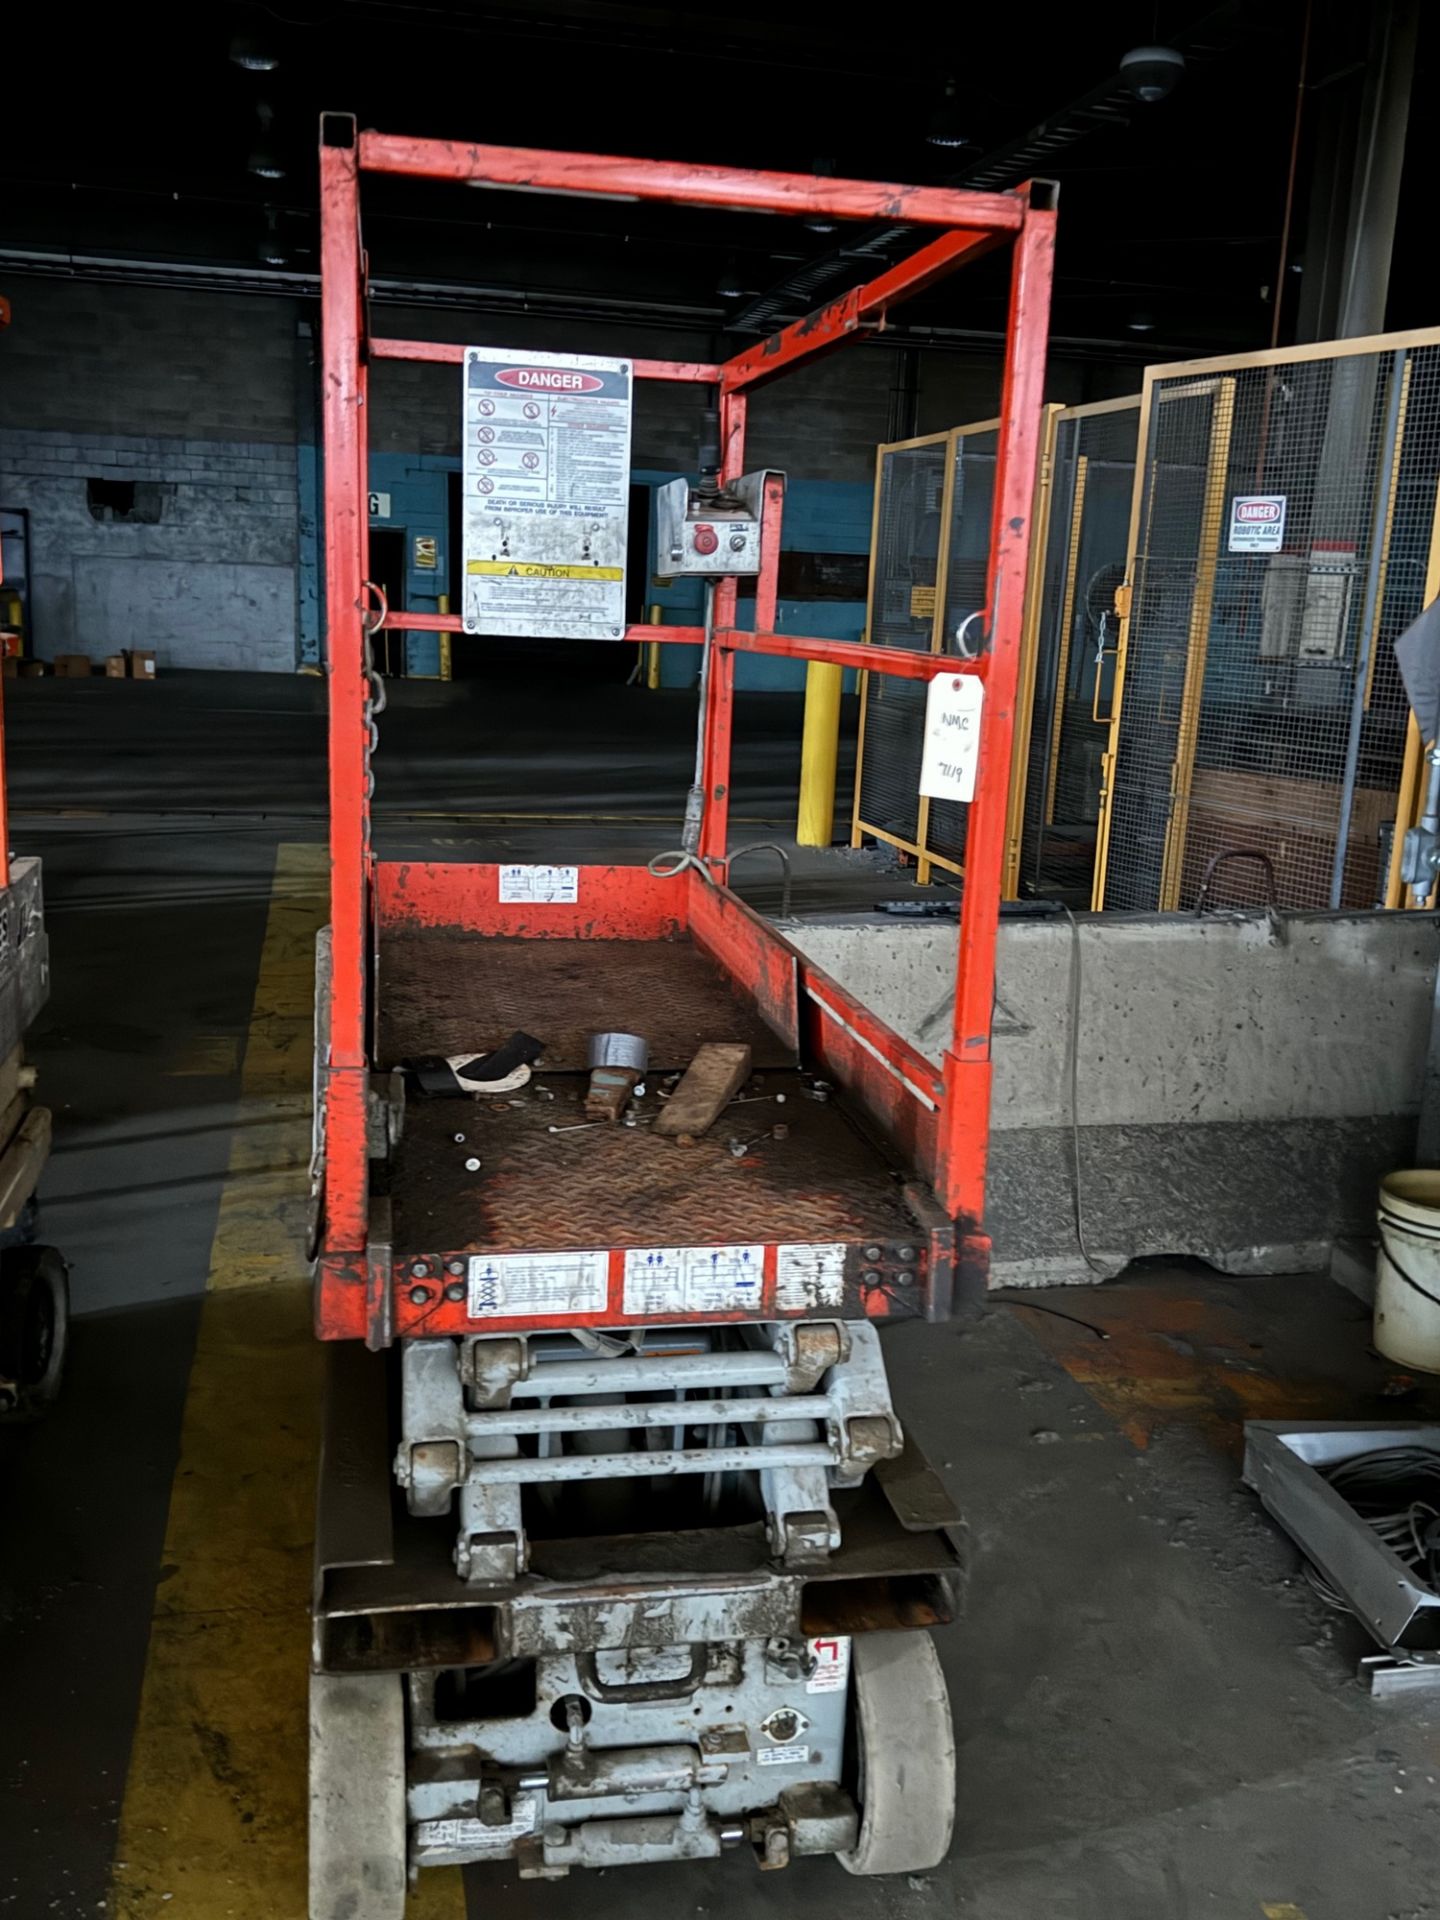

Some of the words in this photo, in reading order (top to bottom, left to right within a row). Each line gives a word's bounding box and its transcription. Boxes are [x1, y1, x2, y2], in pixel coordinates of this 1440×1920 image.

[518, 371, 583, 389] DANGER
[1240, 505, 1276, 519] DANGER
[1233, 525, 1262, 535] ROBOTIC
[1262, 525, 1280, 535] AREA
[525, 567, 570, 578] CAUTION
[941, 712, 970, 731] NMC
